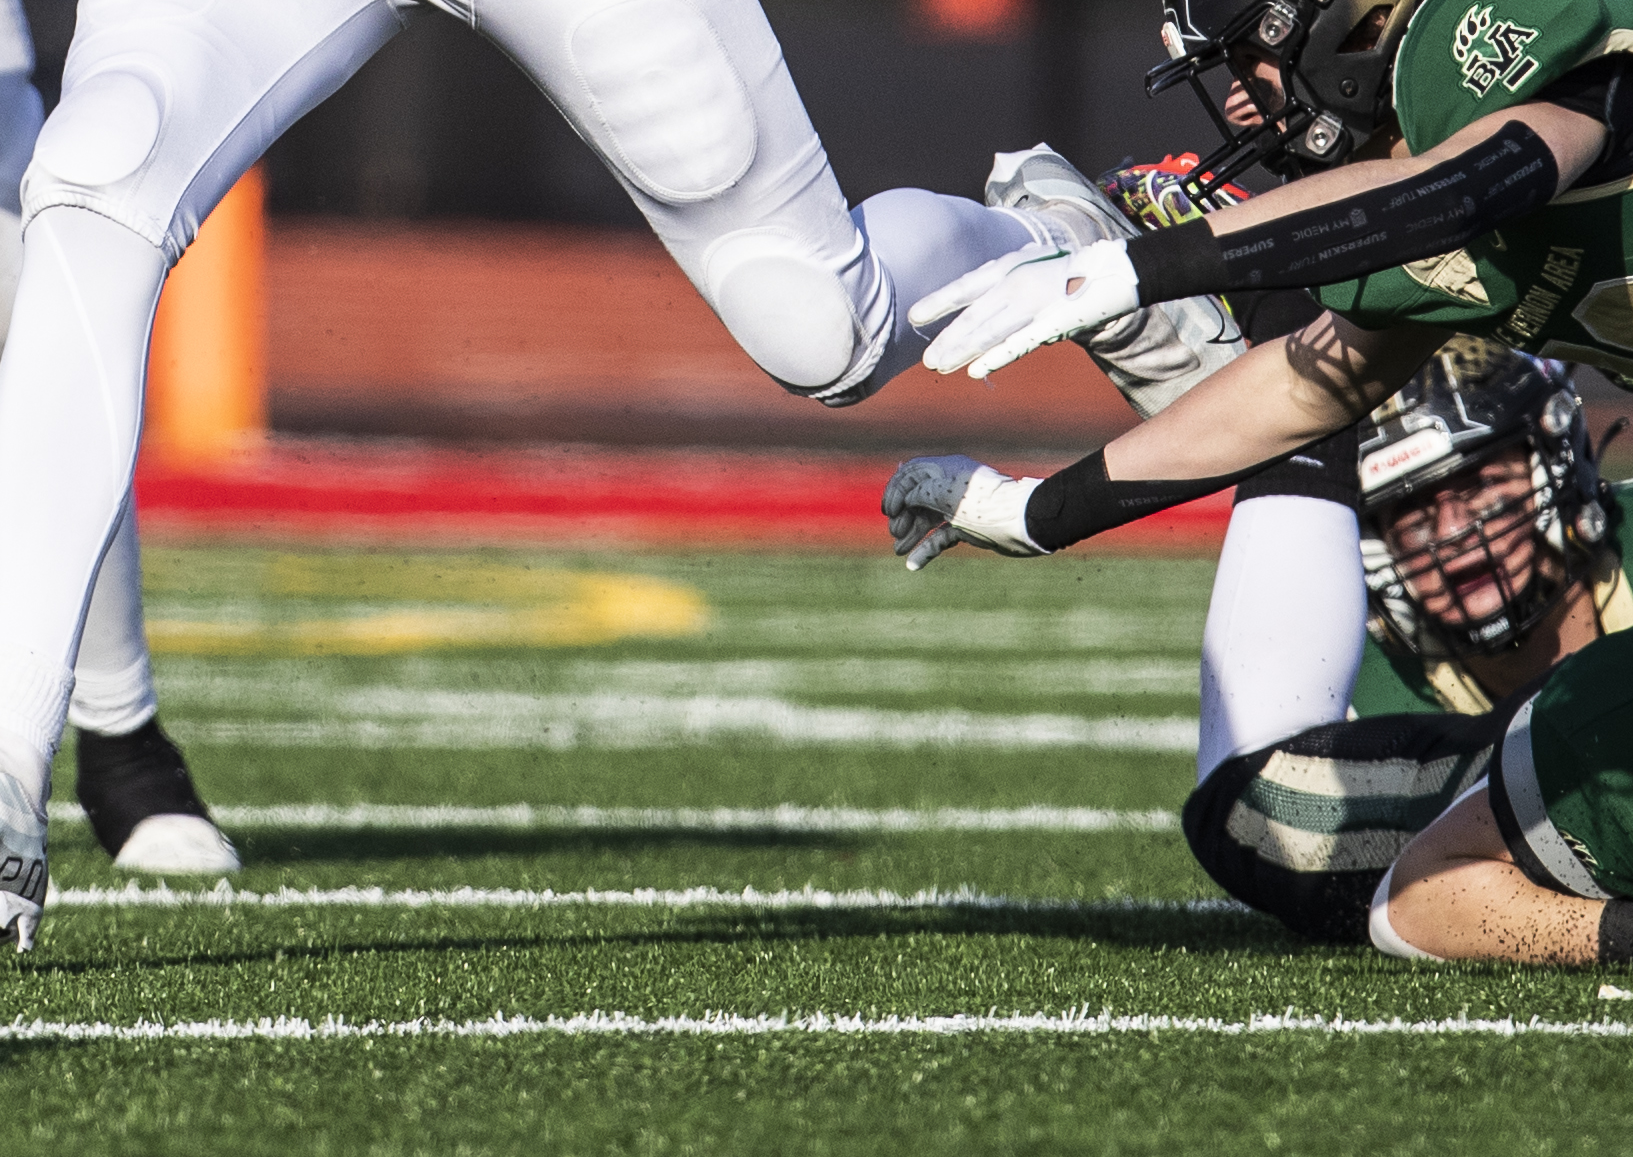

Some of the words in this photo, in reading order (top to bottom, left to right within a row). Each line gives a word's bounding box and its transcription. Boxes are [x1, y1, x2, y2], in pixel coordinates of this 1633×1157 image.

[1462, 21, 1540, 98] BVA
[1291, 222, 1330, 241] MEDIC
[1332, 217, 1350, 230] MY
[1318, 231, 1387, 261] SUPERSKIN
[1505, 284, 1563, 339] VERNON
[1541, 245, 1585, 293] AREA
